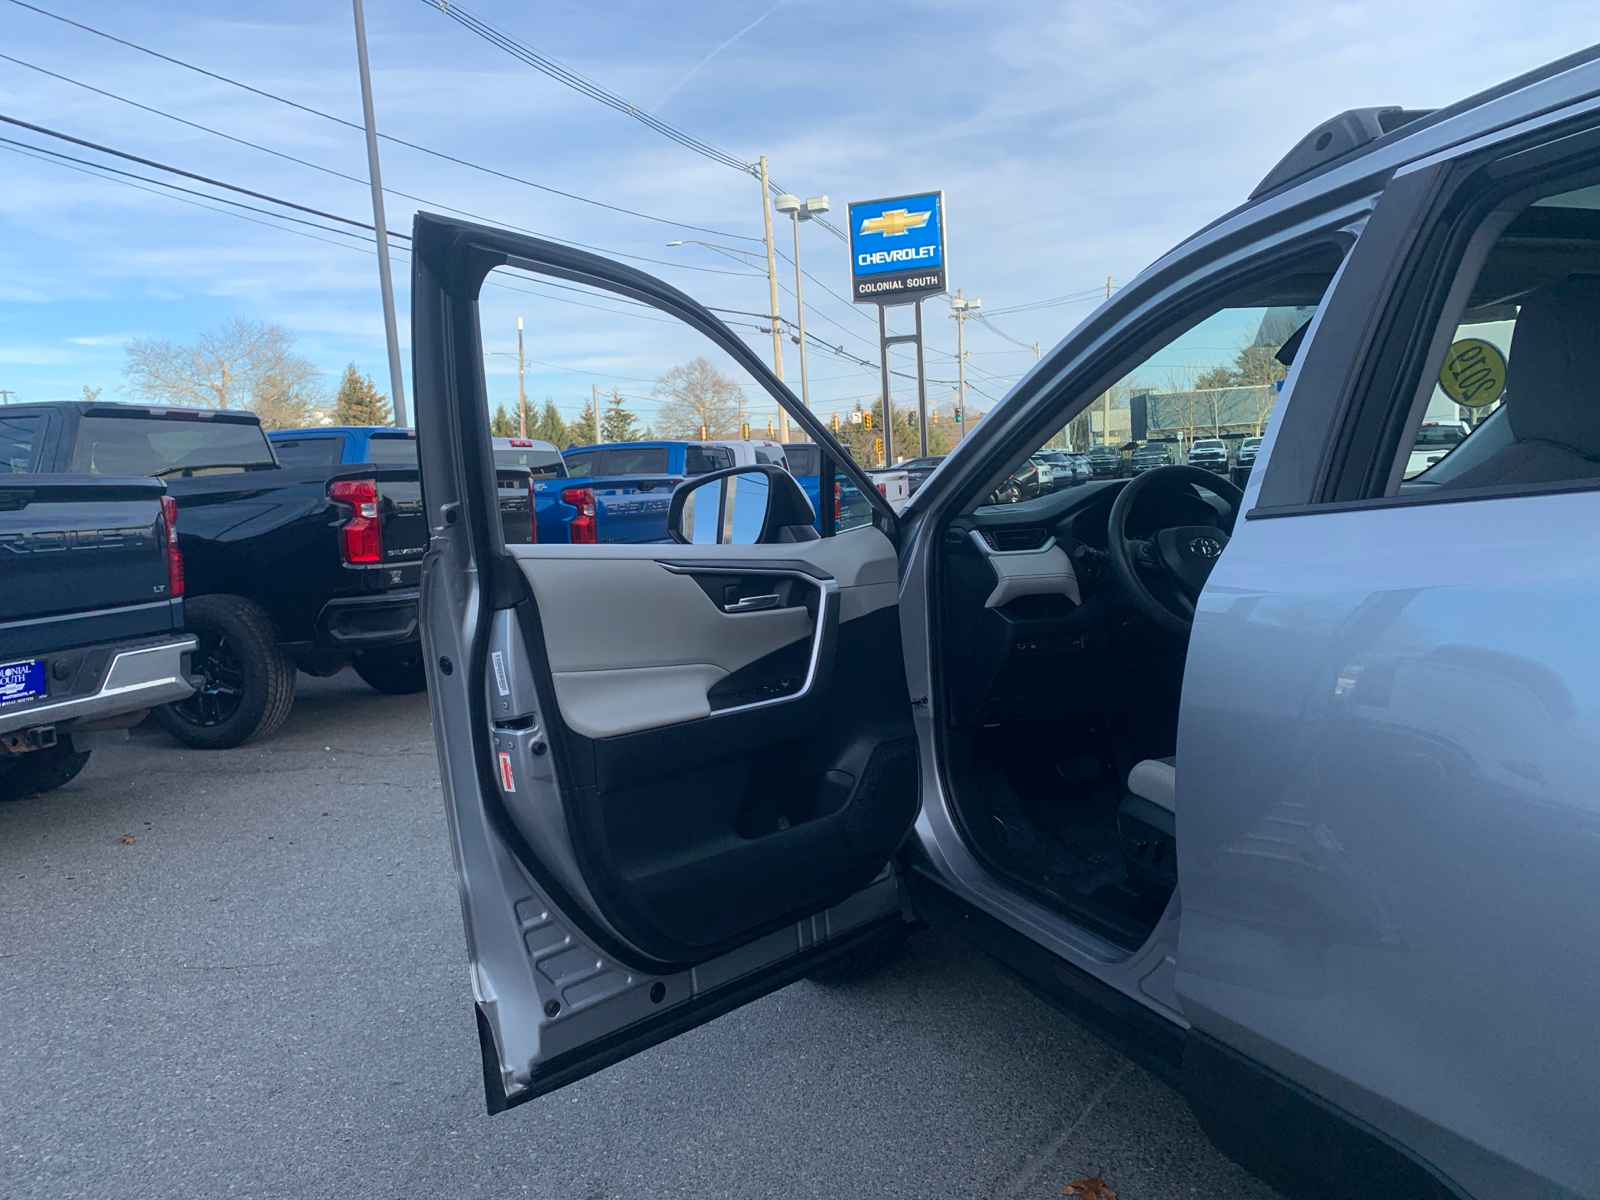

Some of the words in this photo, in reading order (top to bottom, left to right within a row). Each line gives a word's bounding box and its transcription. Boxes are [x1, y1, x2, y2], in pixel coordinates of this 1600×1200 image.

[858, 245, 936, 266] CHEVROLET
[859, 280, 904, 293] COLONIAL
[906, 276, 938, 288] SOUTH
[153, 584, 165, 593] LT
[0, 665, 32, 677] LONIAL
